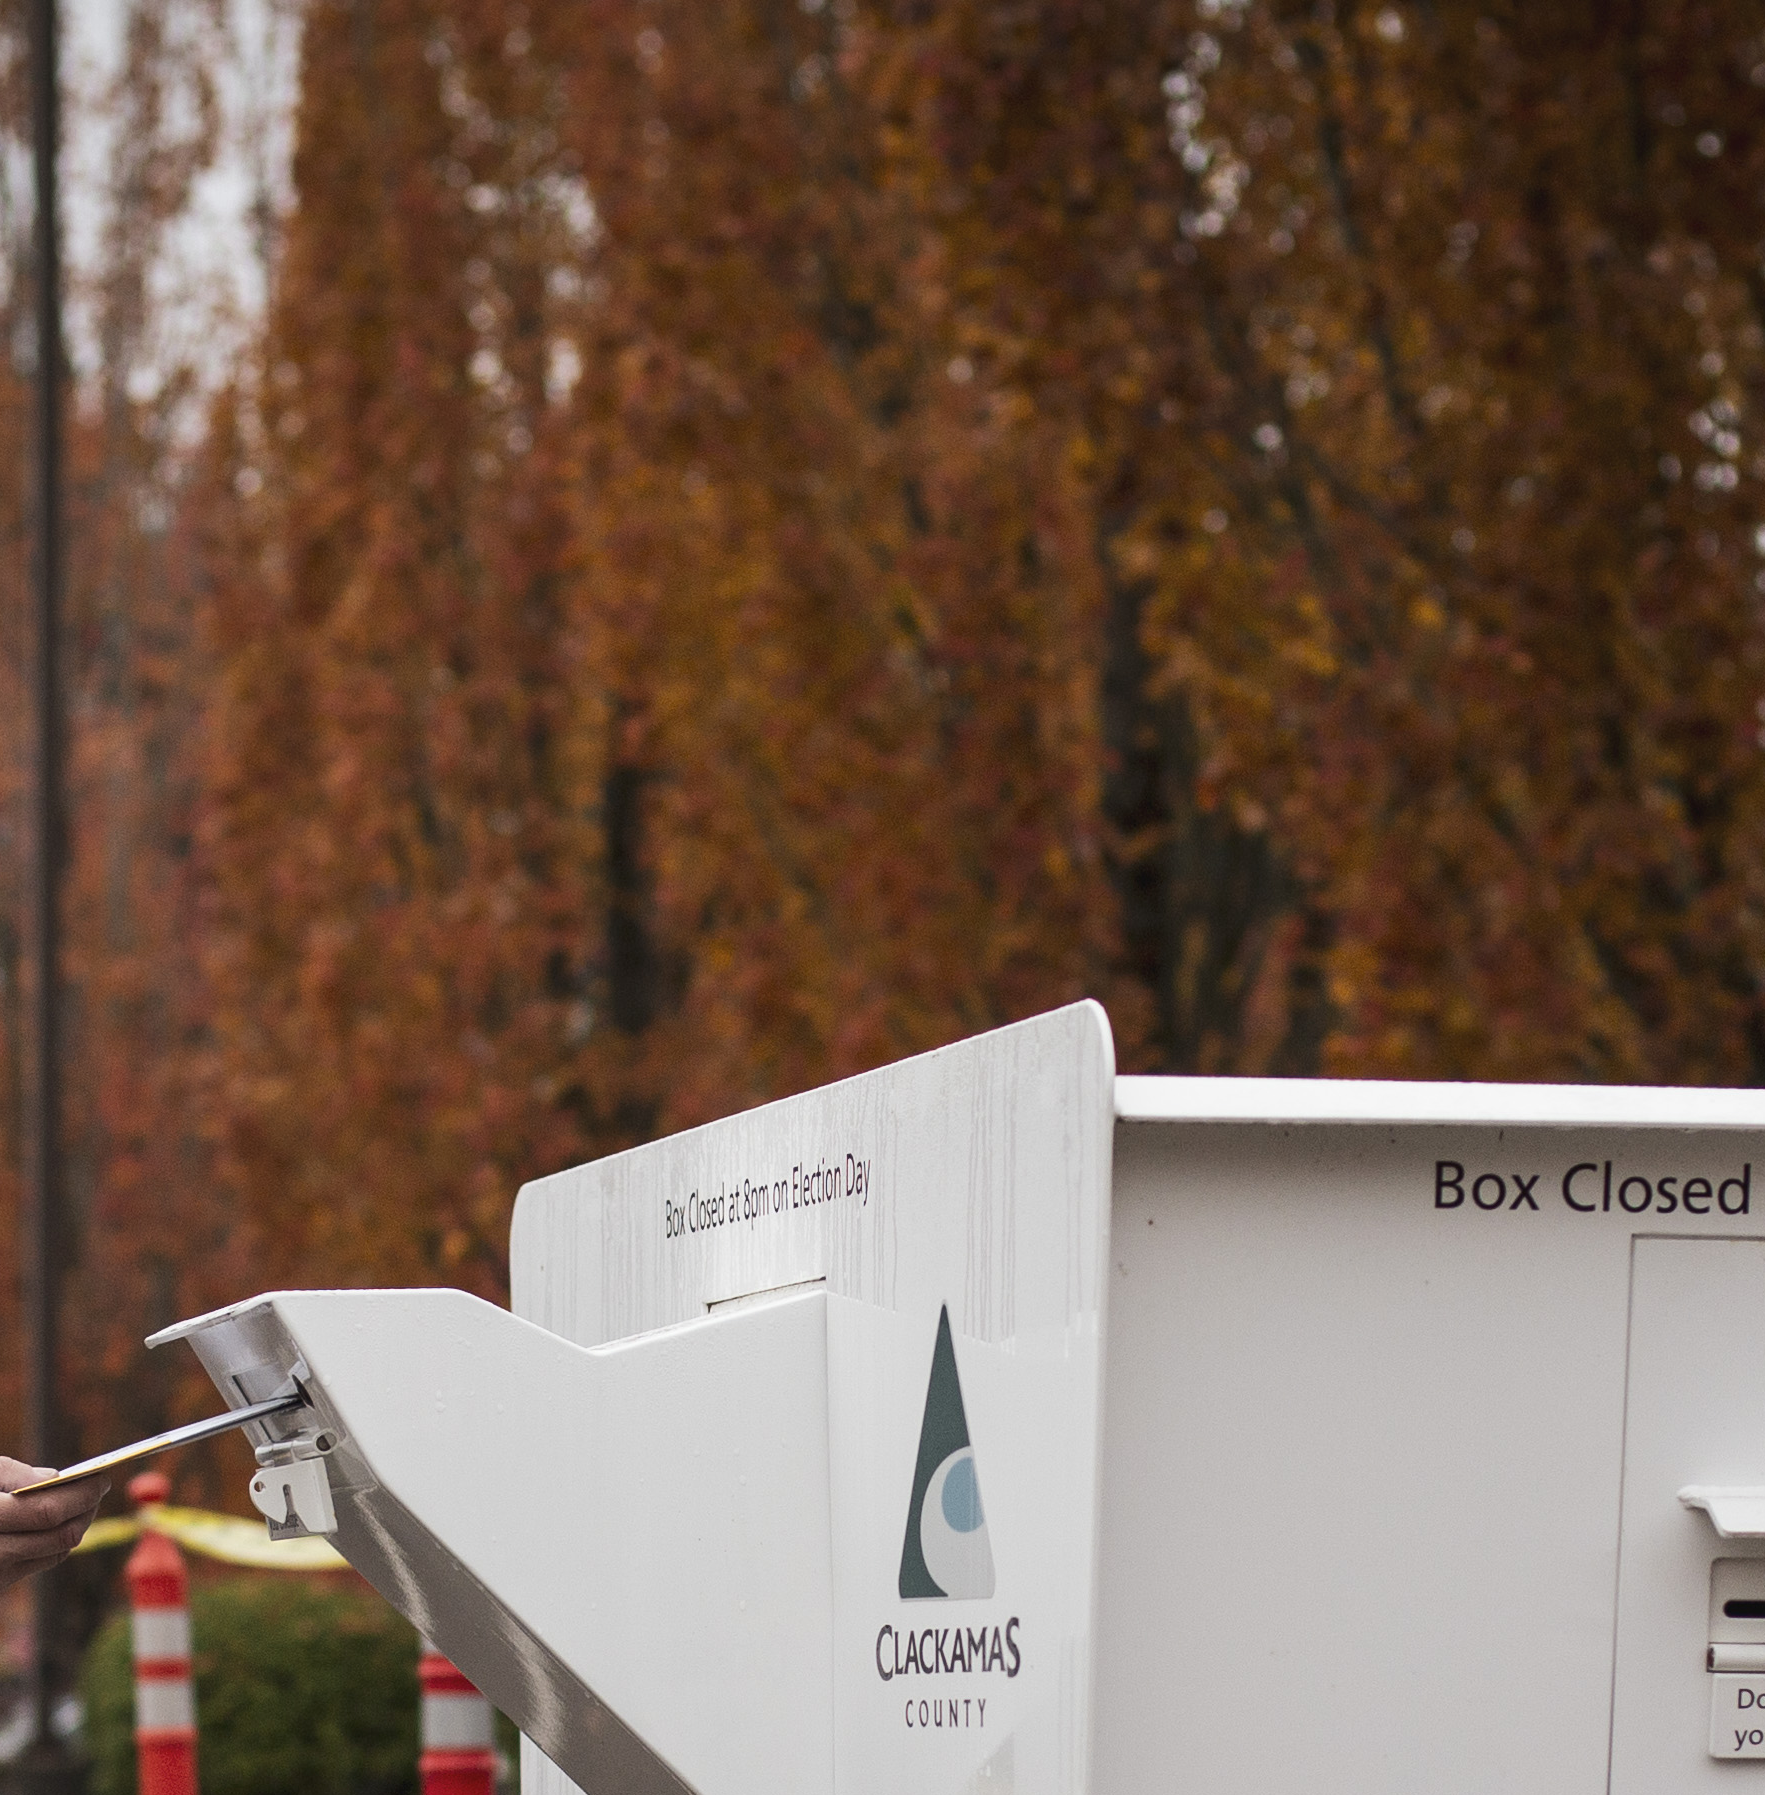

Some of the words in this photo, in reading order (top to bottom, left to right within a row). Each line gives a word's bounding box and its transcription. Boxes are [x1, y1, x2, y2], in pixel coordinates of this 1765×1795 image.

[665, 1199, 685, 1239] Box
[688, 1182, 725, 1233] Closed
[728, 1184, 741, 1224] at
[743, 1178, 769, 1230] 8pm
[773, 1179, 788, 1213] on
[792, 1158, 841, 1209] Election
[846, 1153, 871, 1206] Day
[1433, 1158, 1541, 1211] Box
[1561, 1158, 1753, 1215] Closed
[875, 1616, 1021, 1682] CLACKAMAS
[905, 1698, 986, 1728] COUNTY
